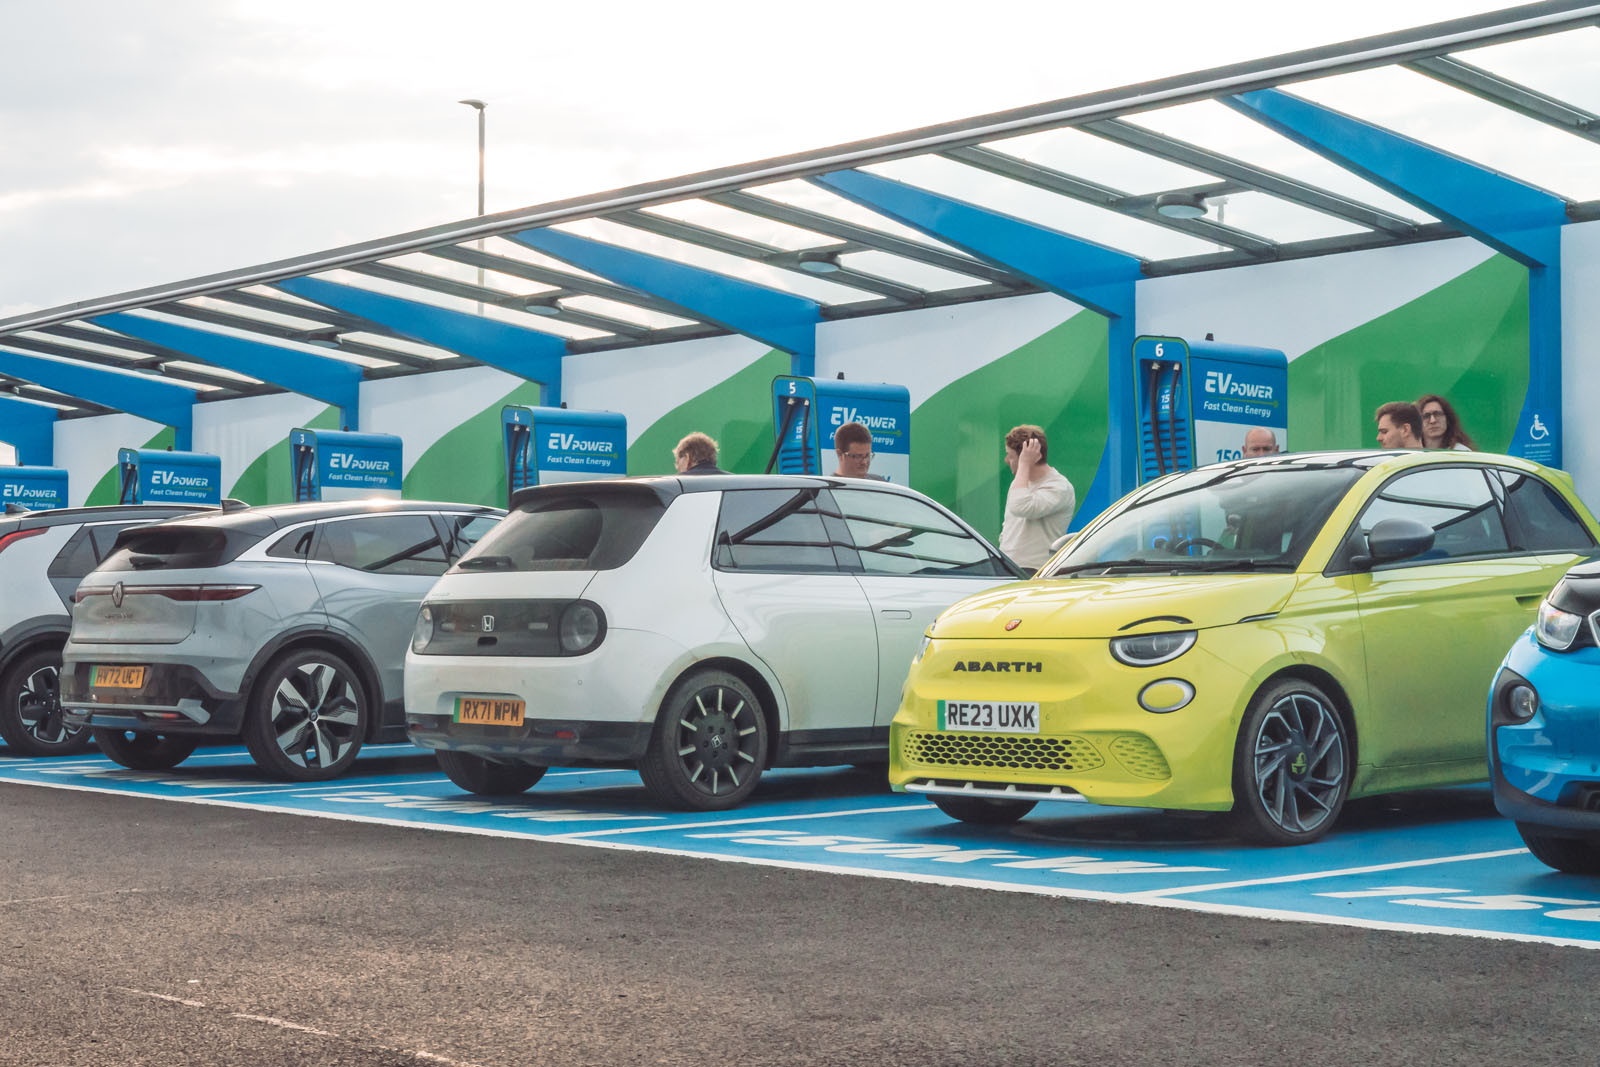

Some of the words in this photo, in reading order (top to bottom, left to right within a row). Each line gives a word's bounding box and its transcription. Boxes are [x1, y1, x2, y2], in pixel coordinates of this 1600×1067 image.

[1155, 343, 1164, 357] 6
[789, 382, 796, 394] 5
[1203, 401, 1220, 411] Fast
[1222, 402, 1243, 413] Clean
[1245, 405, 1272, 418] Energy
[514, 411, 520, 422] 4
[300, 434, 305, 444] 3
[126, 453, 130, 462] 2
[547, 455, 562, 464] Fast
[563, 456, 584, 465] Clean
[586, 457, 611, 467] Energy
[344, 473, 363, 481] Clean
[364, 475, 388, 483] Energy
[184, 490, 207, 498] Energy
[953, 661, 1042, 672] ABARTH
[463, 700, 491, 720] RX71
[948, 703, 993, 727] RE23
[998, 704, 1035, 728] UXK
